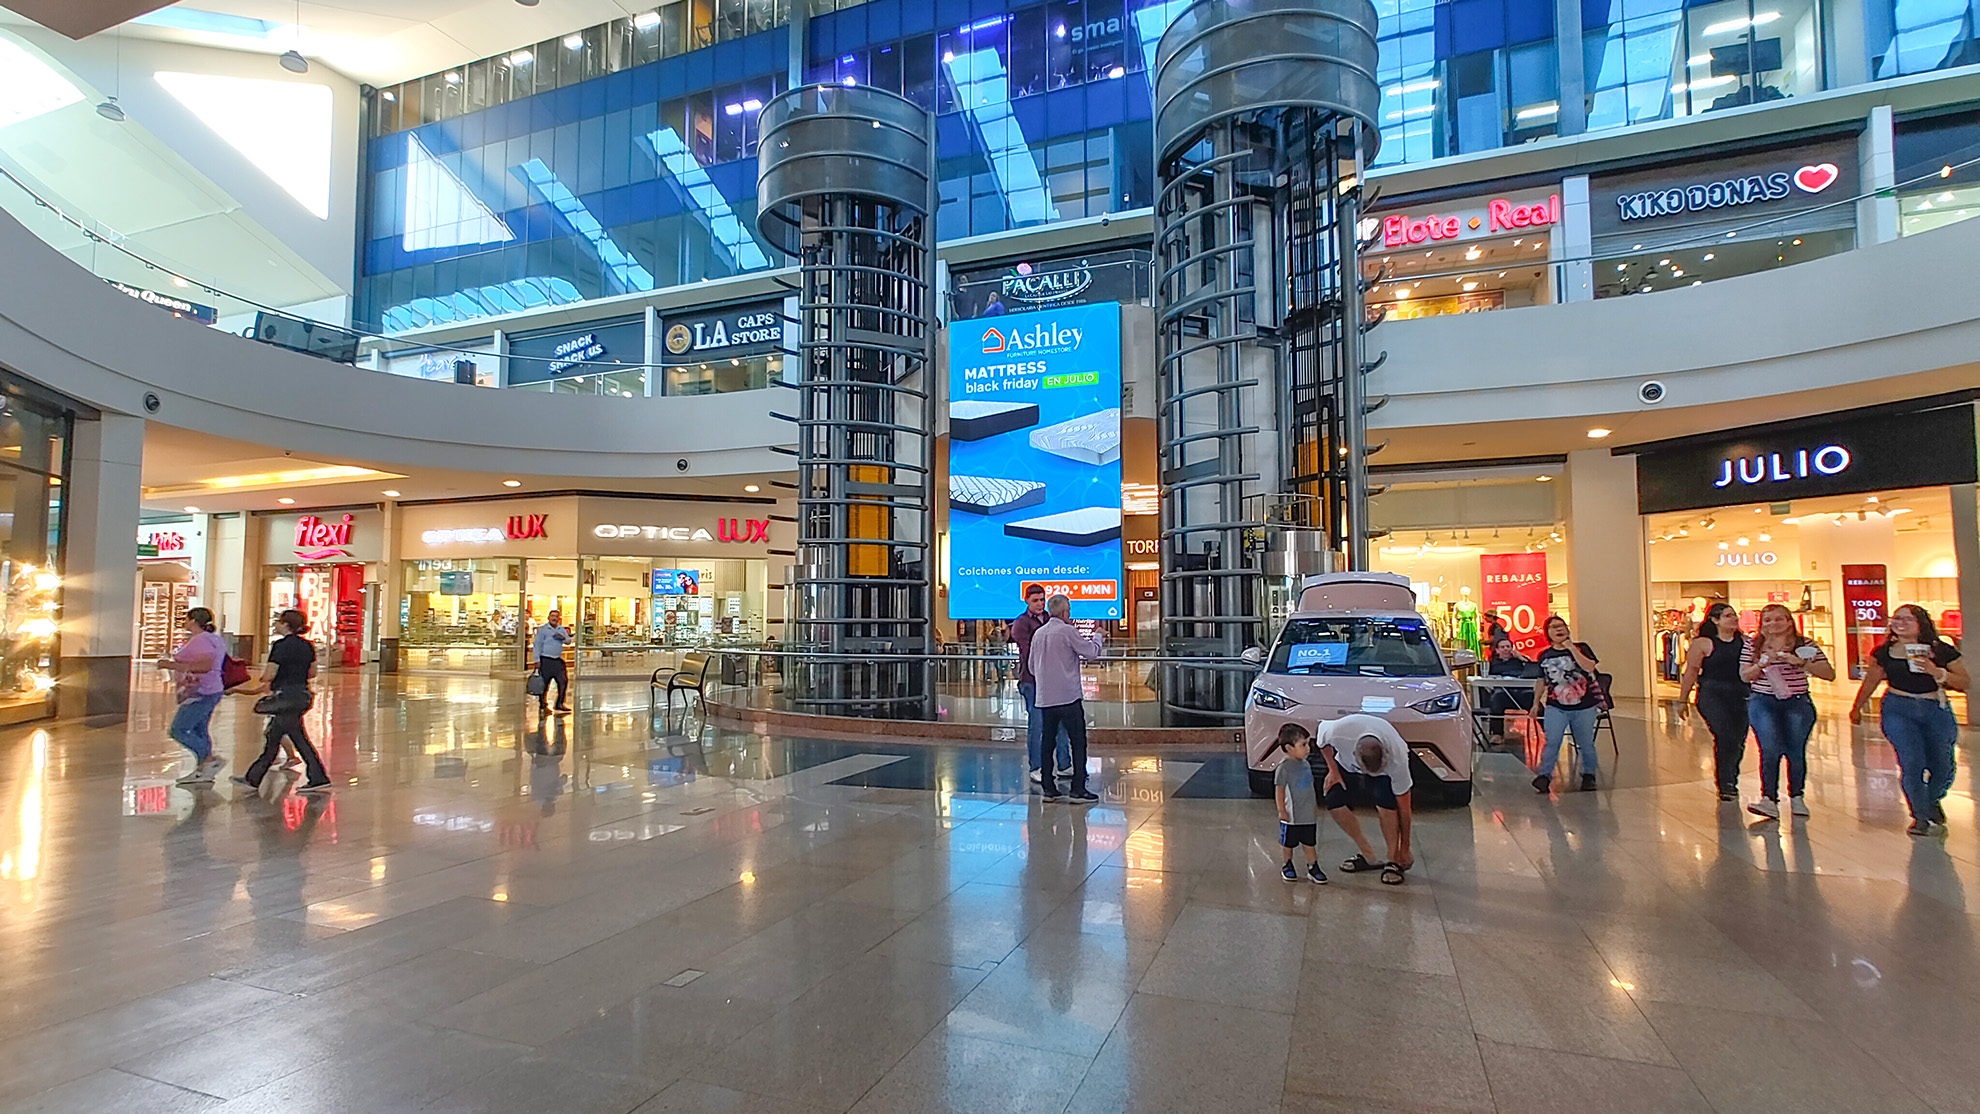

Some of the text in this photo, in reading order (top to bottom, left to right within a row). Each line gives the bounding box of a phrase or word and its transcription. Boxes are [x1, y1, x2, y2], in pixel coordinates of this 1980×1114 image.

[1616, 172, 1790, 221] KIKO DONAS
[1383, 213, 1461, 248] Elote
[1488, 193, 1560, 232] Real
[140, 290, 191, 312] Queen
[737, 312, 775, 329] CAPS
[555, 333, 593, 356] SNACK
[693, 320, 730, 350] LA
[731, 326, 781, 346] STORE
[1006, 321, 1083, 351] Ashley
[587, 344, 603, 357] US
[964, 360, 1047, 381] MATTRESS
[1046, 372, 1096, 387] EN JULIO
[965, 377, 1039, 394] black friday
[1713, 444, 1852, 489] JULIO
[294, 513, 351, 547] flexi
[421, 514, 548, 545] OPTICA LUX
[594, 517, 771, 543] OPTICA LUX
[1715, 552, 1778, 567] JULIO
[958, 564, 1090, 576] Colchones Queen desde:
[1486, 573, 1542, 584] REBAJAS
[1081, 584, 1111, 595] MXN
[1851, 599, 1883, 607] TODO
[1297, 648, 1331, 658] NO.1
